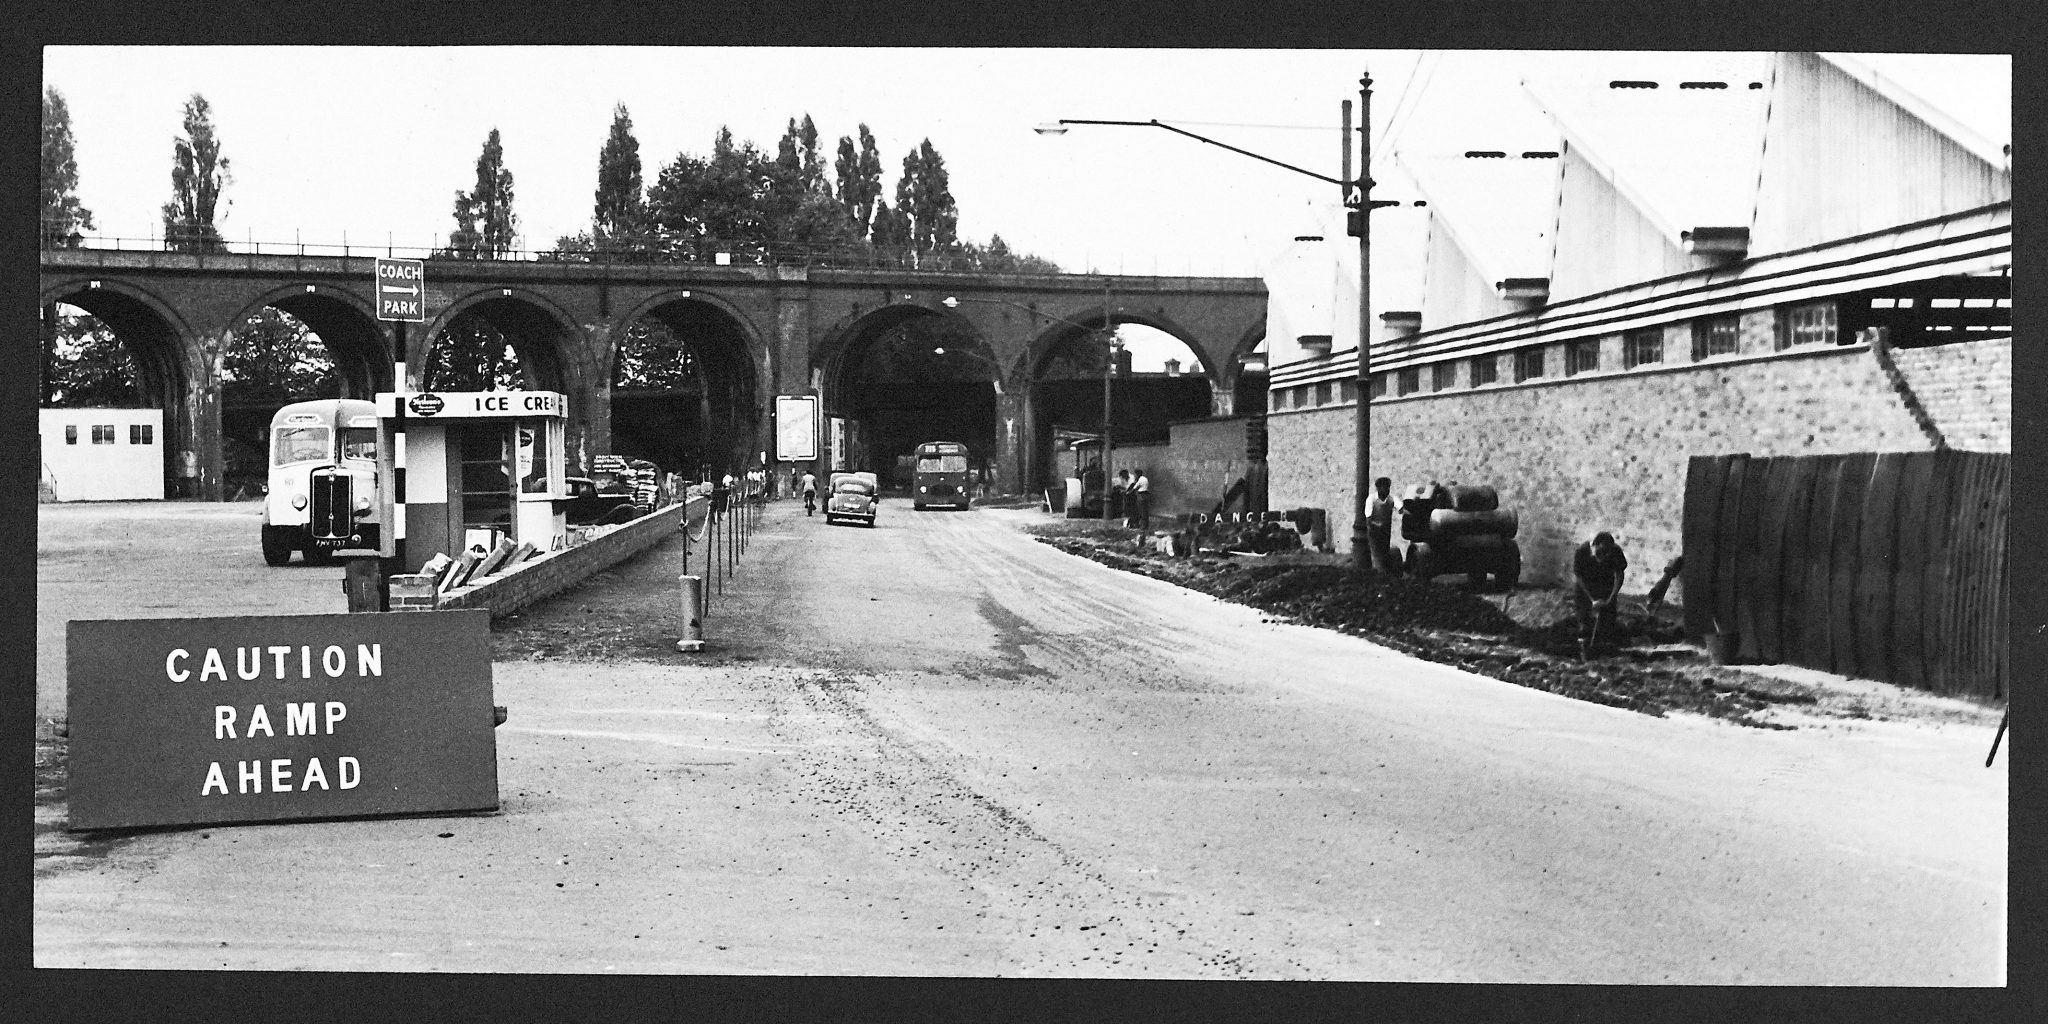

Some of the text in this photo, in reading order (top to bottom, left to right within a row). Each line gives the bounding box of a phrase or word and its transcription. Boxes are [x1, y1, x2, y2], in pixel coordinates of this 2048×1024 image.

[379, 265, 421, 279] COACH
[384, 300, 417, 314] PARK
[476, 397, 508, 411] ICE
[167, 644, 381, 682] CAUTION
[216, 702, 346, 739] RAMP
[202, 757, 360, 795] AHEAD
